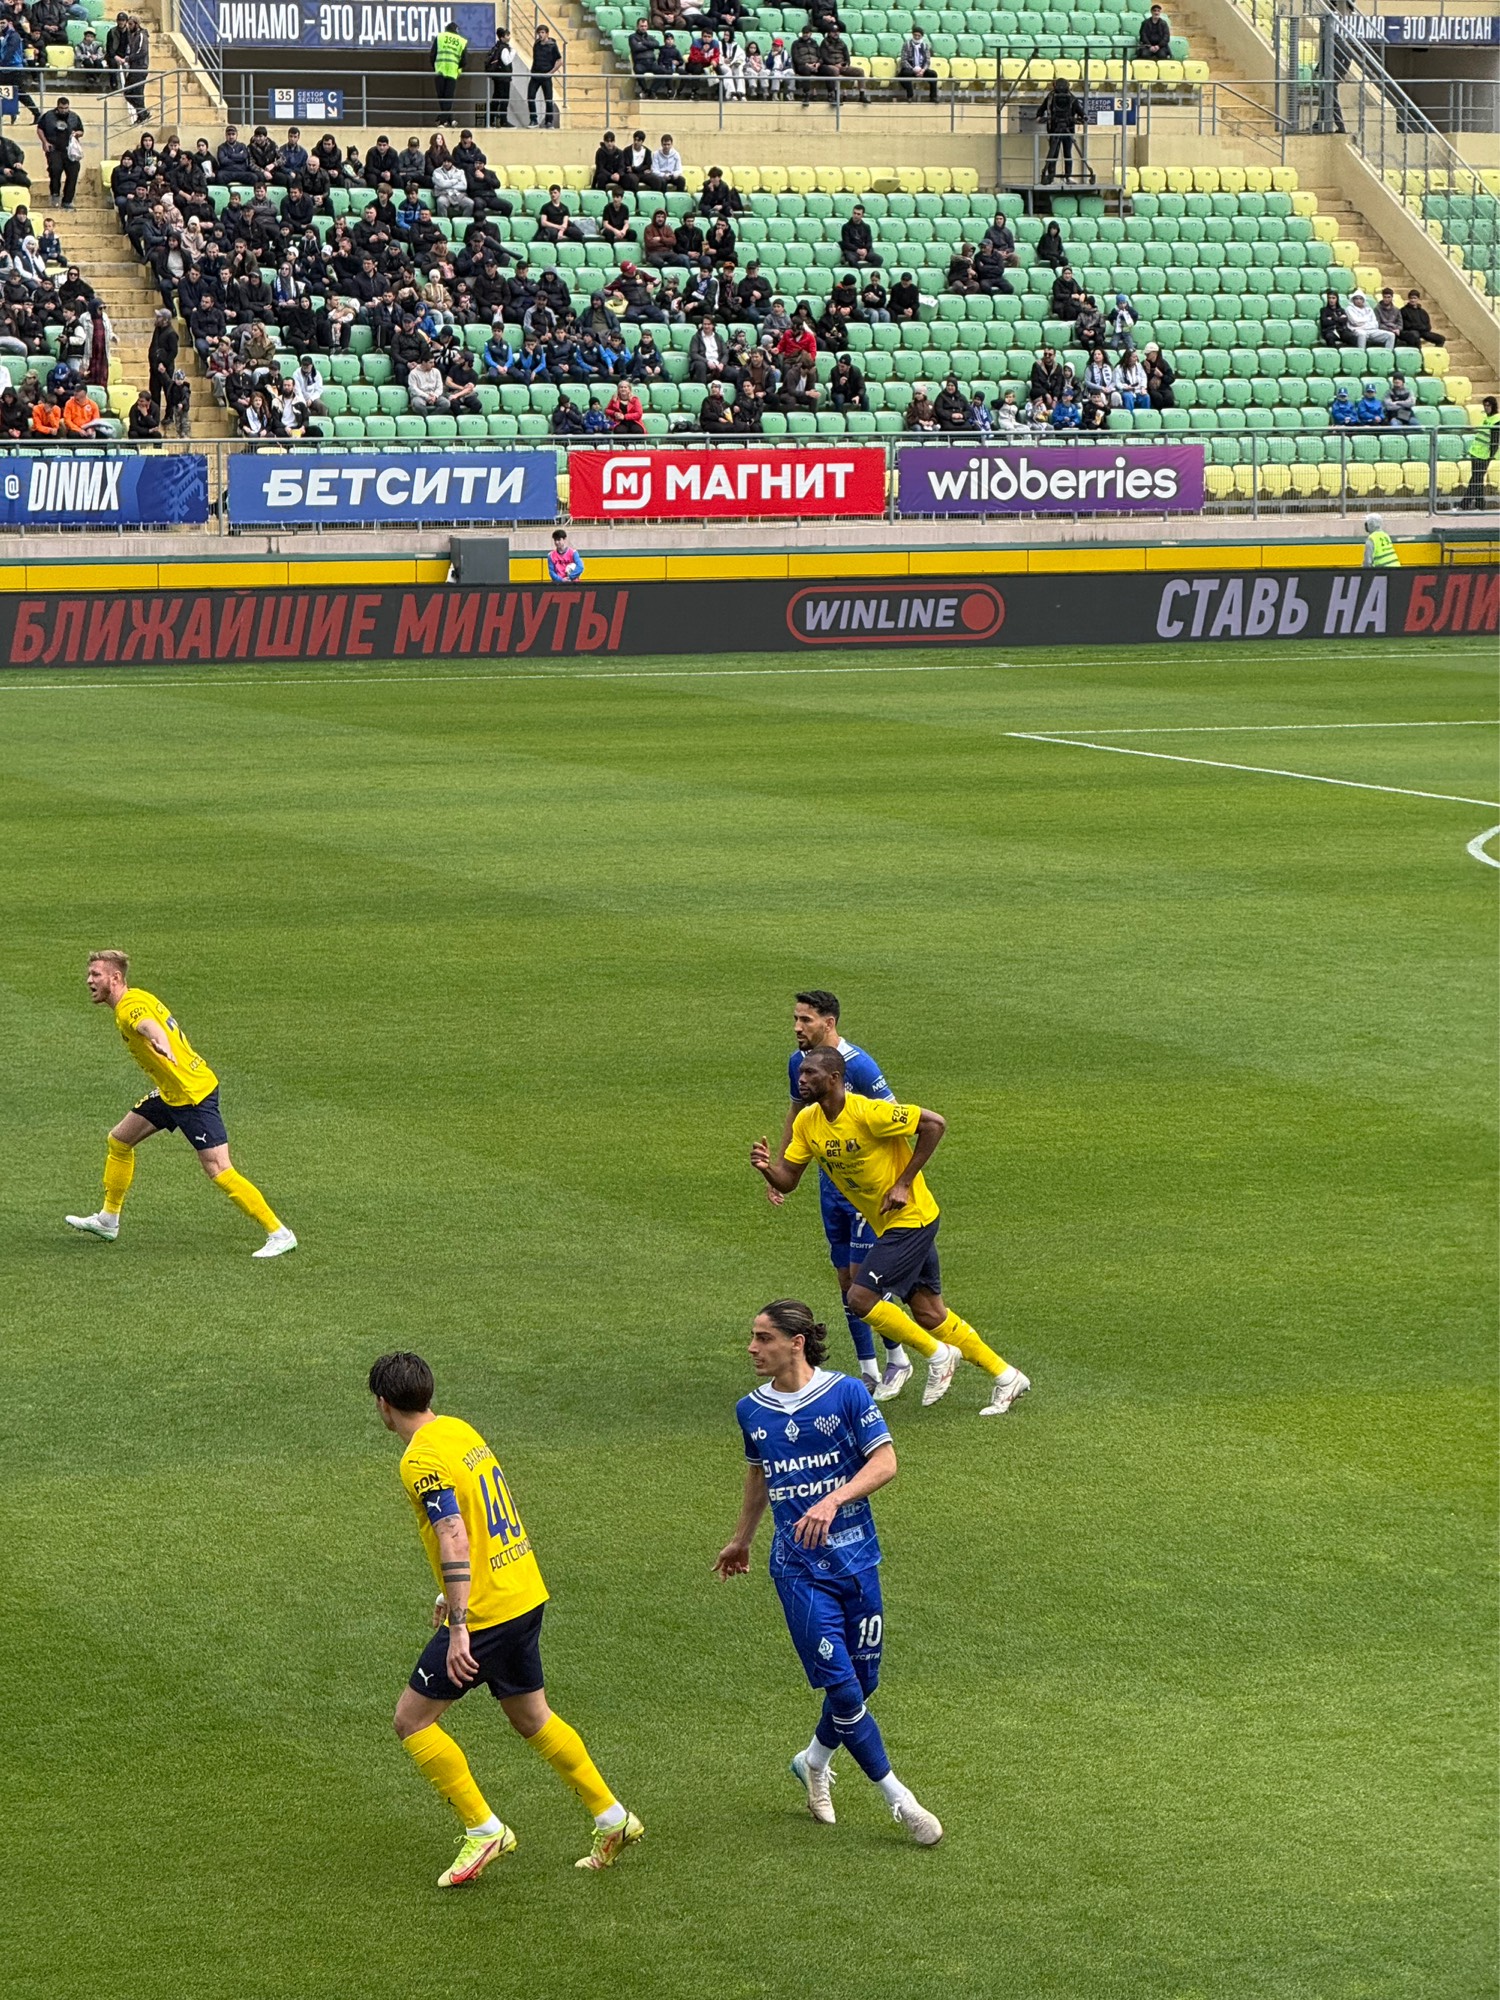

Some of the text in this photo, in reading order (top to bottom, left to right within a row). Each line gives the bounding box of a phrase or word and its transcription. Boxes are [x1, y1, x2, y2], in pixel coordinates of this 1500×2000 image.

[216, 3, 299, 43] ДИНАМО
[320, 5, 353, 40] ЭТО
[1403, 16, 1425, 40] ЭТО
[1429, 16, 1492, 42] ДАГЕСТАН
[277, 90, 292, 101] 35
[28, 461, 122, 511] DINMX
[262, 467, 525, 506] БЕТСИТИ
[666, 462, 854, 500] МАГНИТ
[928, 457, 1178, 501] wildberries
[805, 597, 958, 631] WINLINE
[1156, 577, 1309, 639] СТАВЬ
[1323, 575, 1388, 634] НА
[10, 590, 629, 664] БЛИЖАЙШИЕ МИНУТЫ
[825, 1140, 840, 1149] FON
[827, 1149, 842, 1157] BET
[774, 1451, 840, 1474] МАГНИТ
[413, 1471, 440, 1494] FON
[768, 1475, 847, 1501] БЕТСИТИ
[479, 1465, 521, 1546] 40
[857, 1614, 882, 1649] 10
